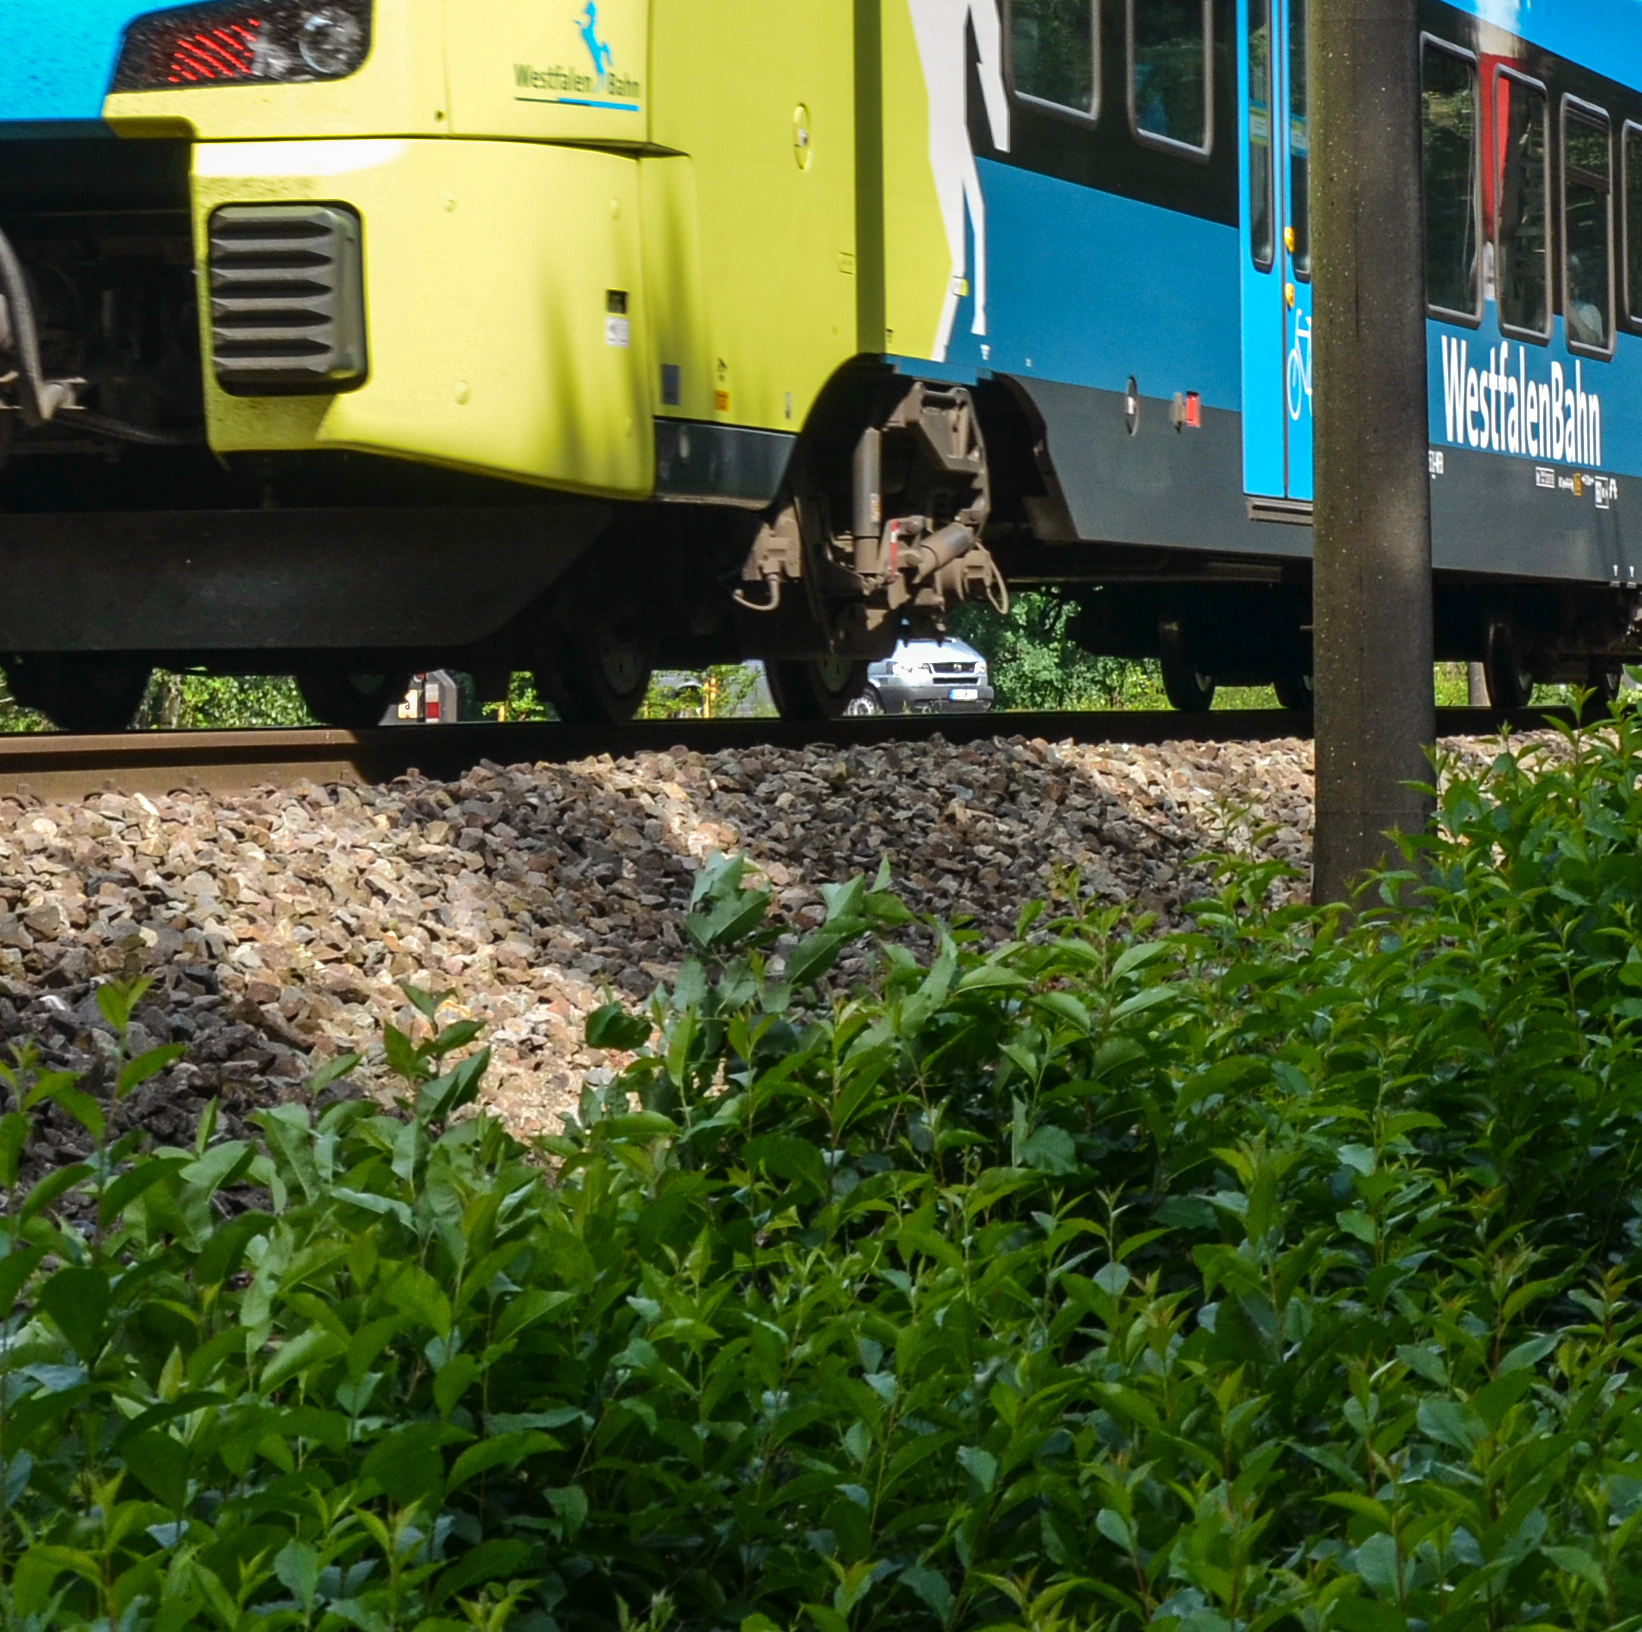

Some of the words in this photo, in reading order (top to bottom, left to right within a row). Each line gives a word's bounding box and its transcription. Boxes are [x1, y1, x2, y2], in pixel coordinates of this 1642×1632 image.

[514, 63, 593, 94] Westfalen
[608, 71, 640, 98] Bahn
[1442, 334, 1602, 467] WestfalenBahn
